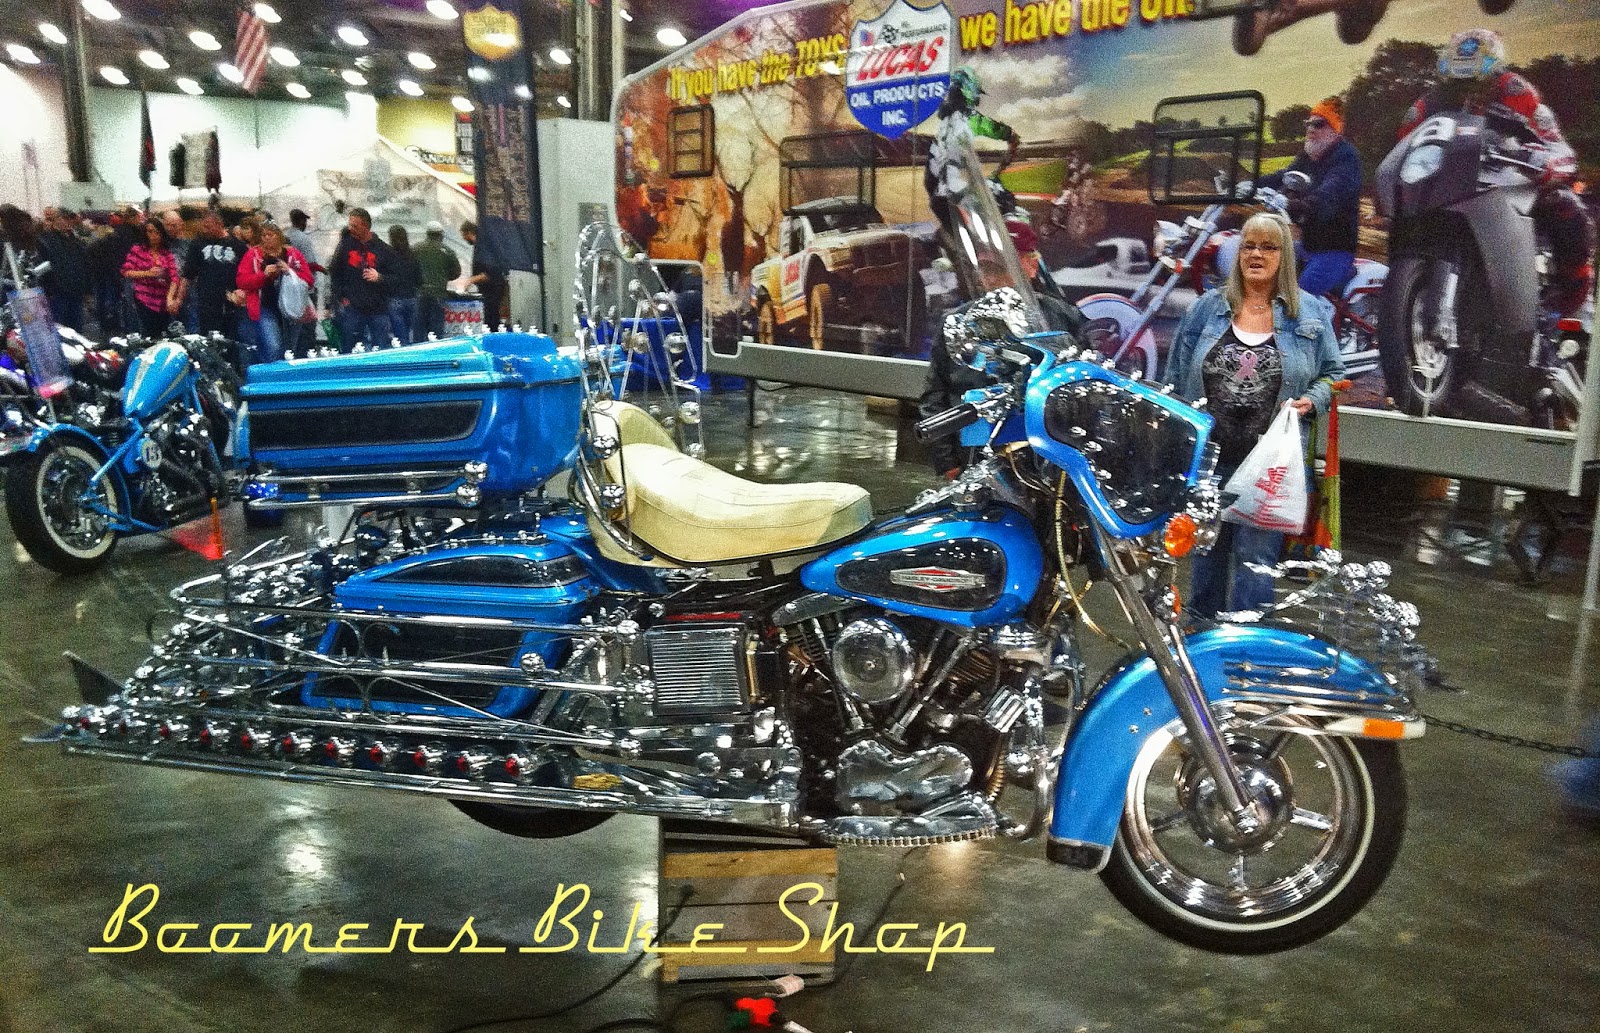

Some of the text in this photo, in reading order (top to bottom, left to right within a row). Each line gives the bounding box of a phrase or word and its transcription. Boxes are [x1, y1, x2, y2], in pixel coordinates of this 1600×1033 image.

[959, 11, 998, 51] we
[1003, 0, 1073, 43] have
[684, 67, 713, 104] you
[717, 58, 758, 92] have
[760, 50, 791, 84] the
[856, 36, 944, 81] LUCAS
[850, 81, 945, 108] OIL PRODUCTS
